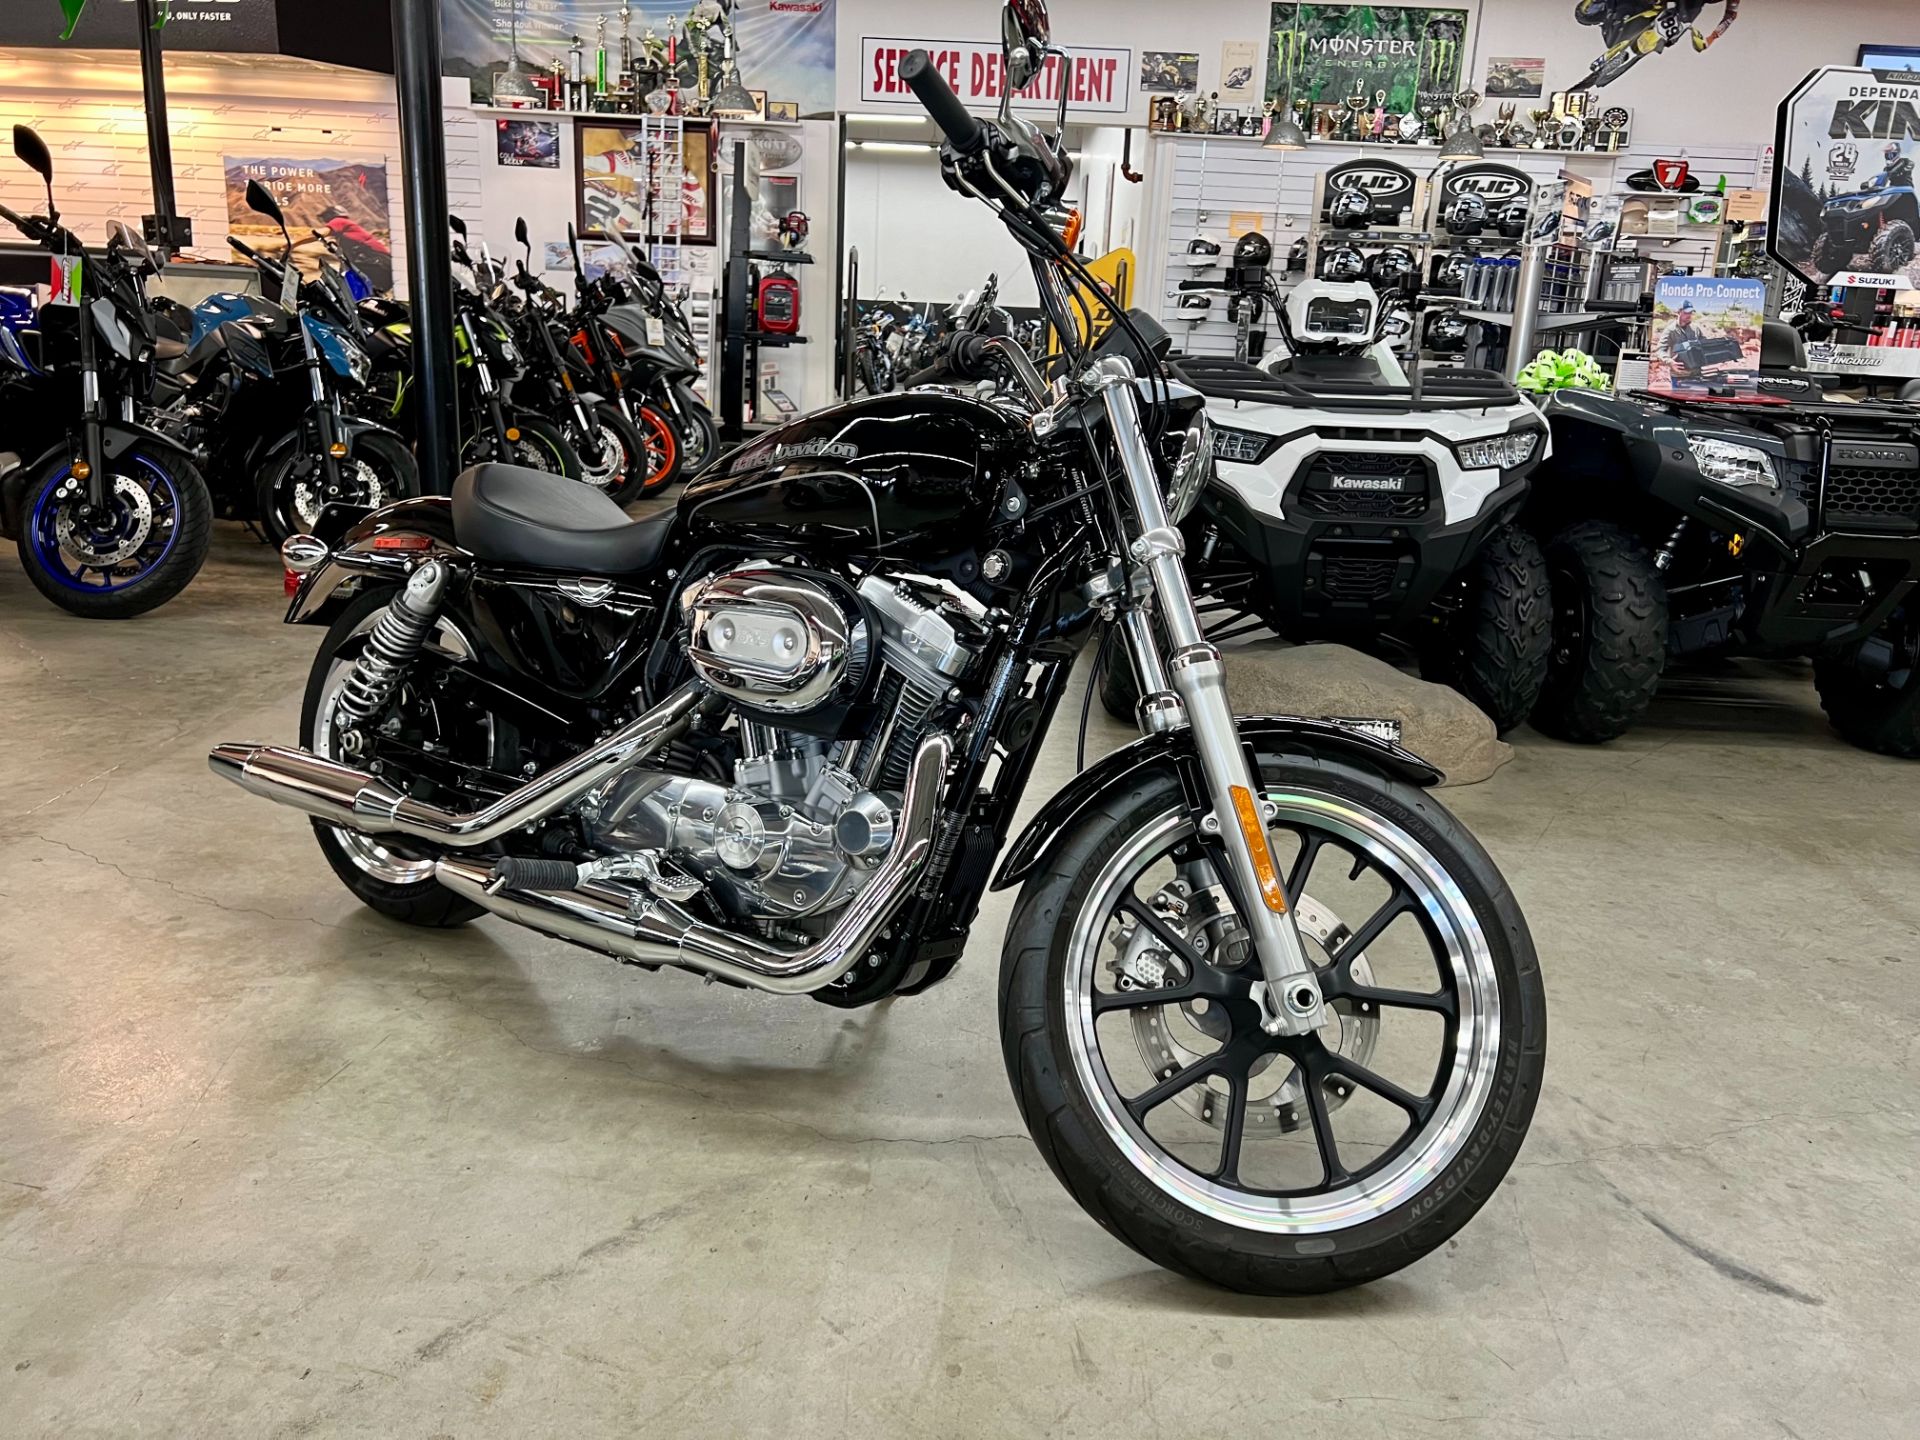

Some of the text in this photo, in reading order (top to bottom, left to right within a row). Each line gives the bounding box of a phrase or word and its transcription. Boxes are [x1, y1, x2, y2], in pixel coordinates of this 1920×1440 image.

[769, 1, 823, 12] Kawasaki
[176, 11, 198, 20] ONLY
[199, 11, 232, 21] FASTER
[1309, 35, 1417, 57] MONSTER
[1325, 59, 1400, 69] ENERGY
[1848, 86, 1920, 100] DEPENDA
[242, 165, 315, 178] THE POWER
[1664, 166, 1681, 184] 1
[265, 182, 293, 193] RIDE
[297, 184, 332, 194] MORE
[1342, 175, 1401, 189] HJC
[1458, 179, 1516, 193] HJC
[1858, 276, 1896, 286] SUZUKI
[1661, 282, 1761, 299] Honda Pro-Connect
[1757, 376, 1809, 387] RANCHER
[1837, 448, 1912, 463] HONDA
[1333, 475, 1403, 490] Kawasaki
[1409, 1037, 1521, 1221] HARLEY-DAVIDSON
[1129, 1176, 1205, 1231] SCORCHER
